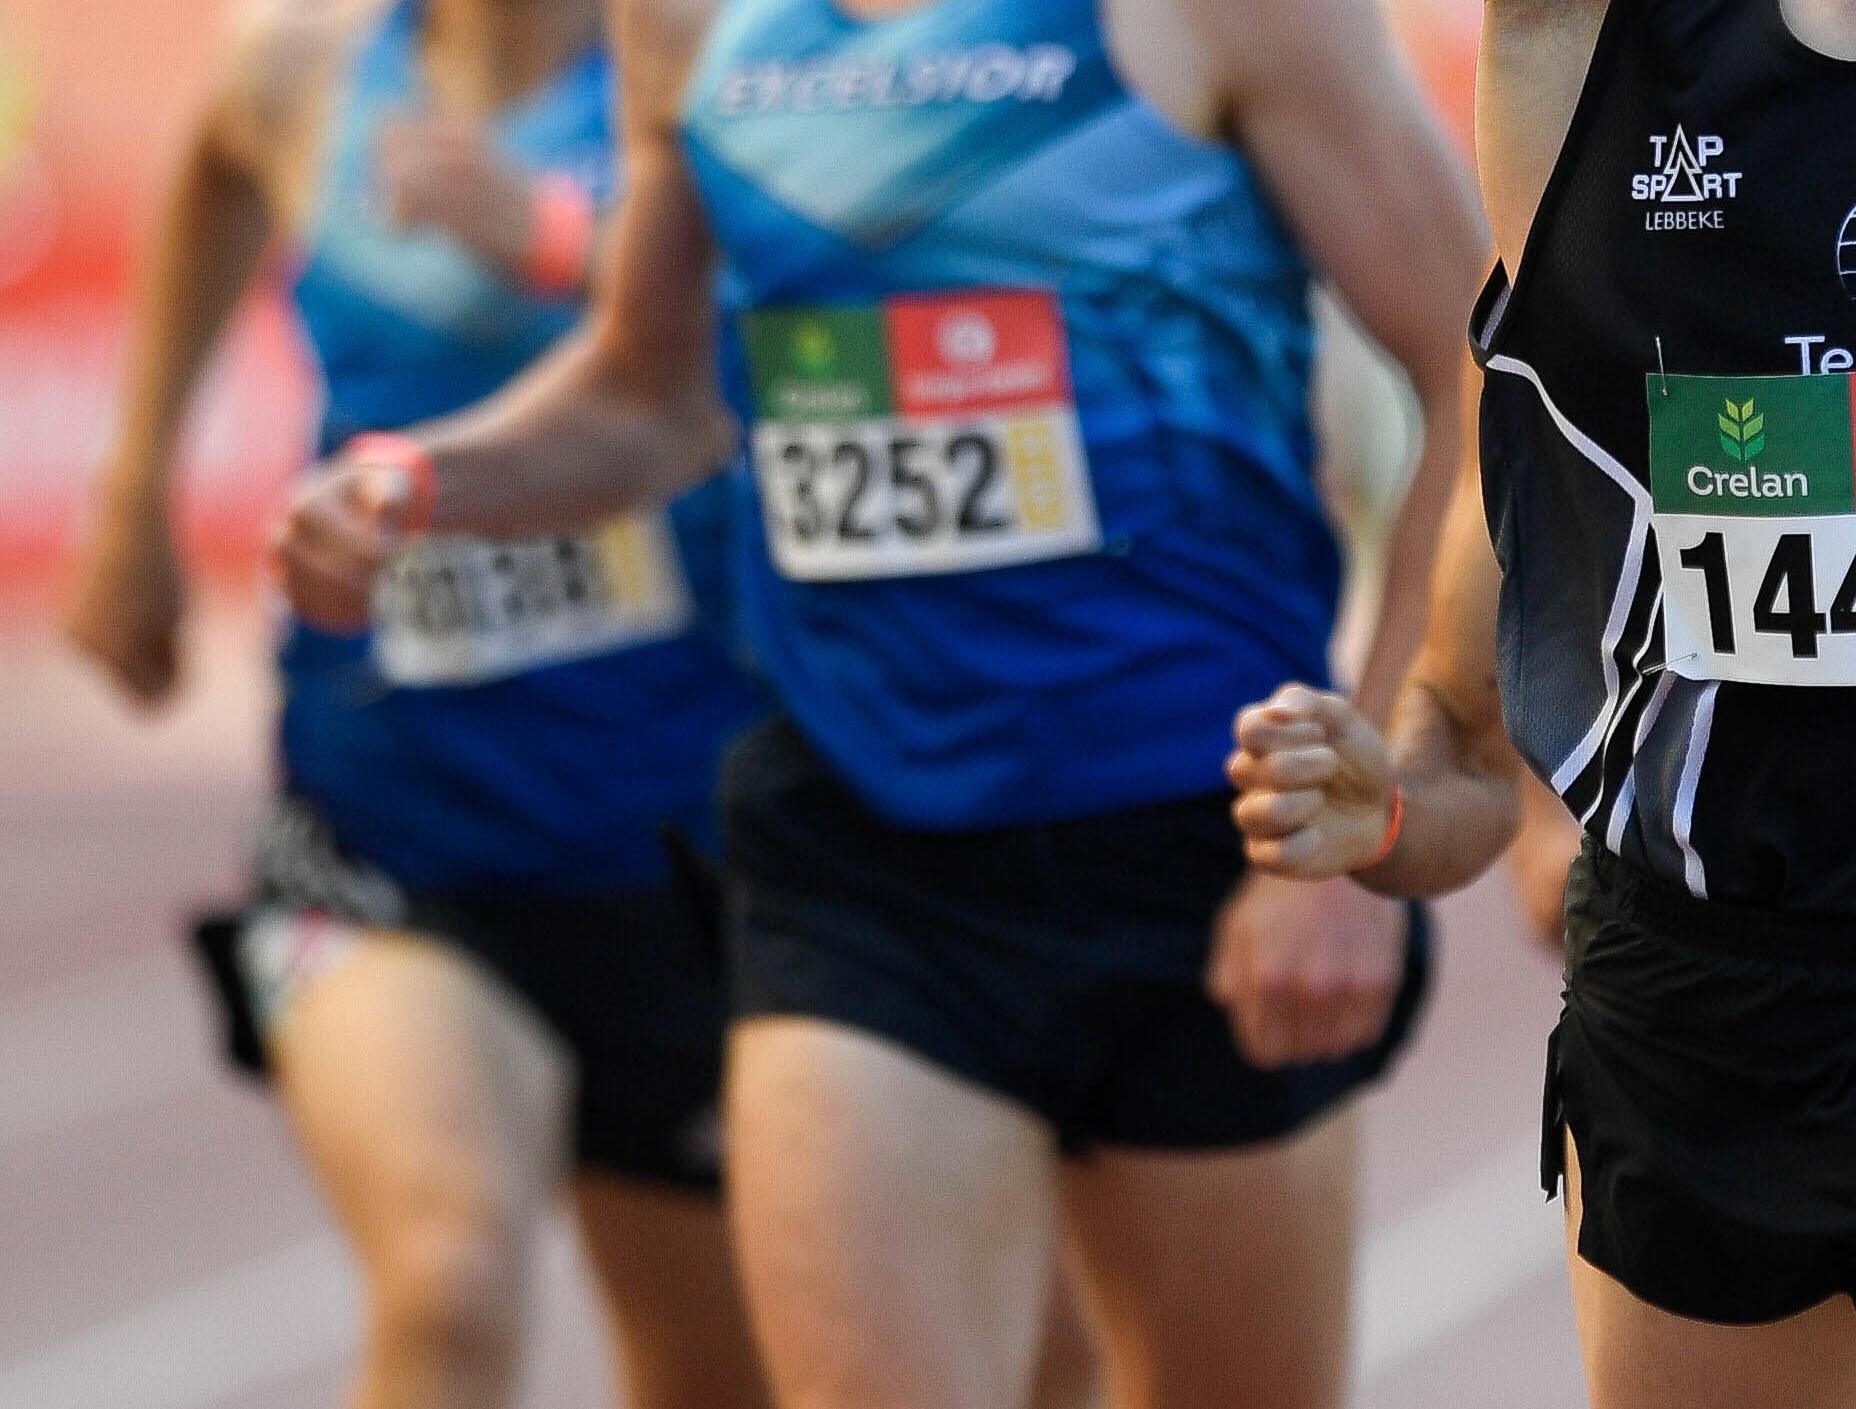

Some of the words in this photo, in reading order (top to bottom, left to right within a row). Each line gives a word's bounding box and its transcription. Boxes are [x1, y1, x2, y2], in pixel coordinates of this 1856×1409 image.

[1645, 210, 1725, 231] LEBBEKE
[781, 434, 1010, 541] 3252
[1687, 466, 1809, 498] Crelan
